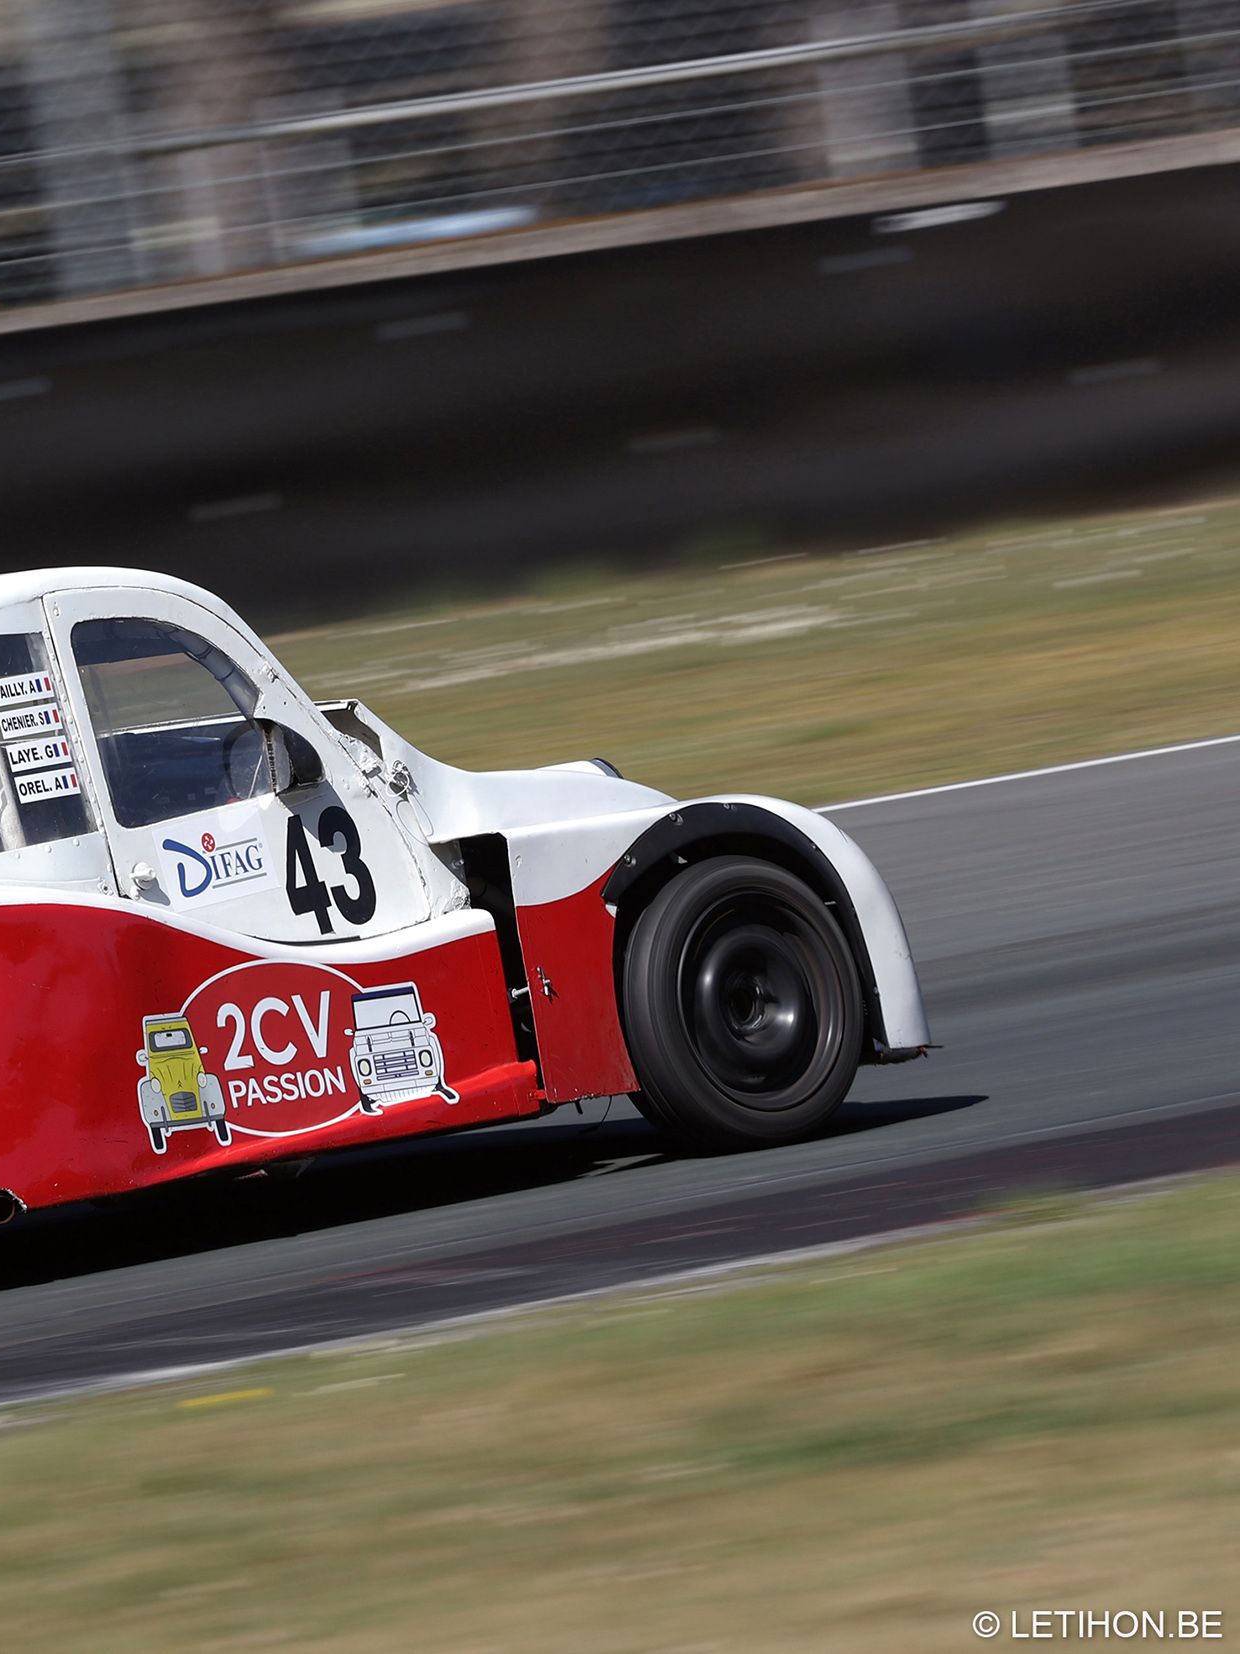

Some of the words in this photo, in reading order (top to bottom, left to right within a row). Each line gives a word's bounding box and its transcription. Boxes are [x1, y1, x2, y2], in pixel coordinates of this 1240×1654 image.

[45, 745, 54, 758] G
[55, 777, 63, 790] A
[163, 838, 263, 897] DIFAG
[286, 806, 377, 935] 43
[216, 990, 331, 1072] 2CV
[228, 1066, 347, 1108] PASSION
